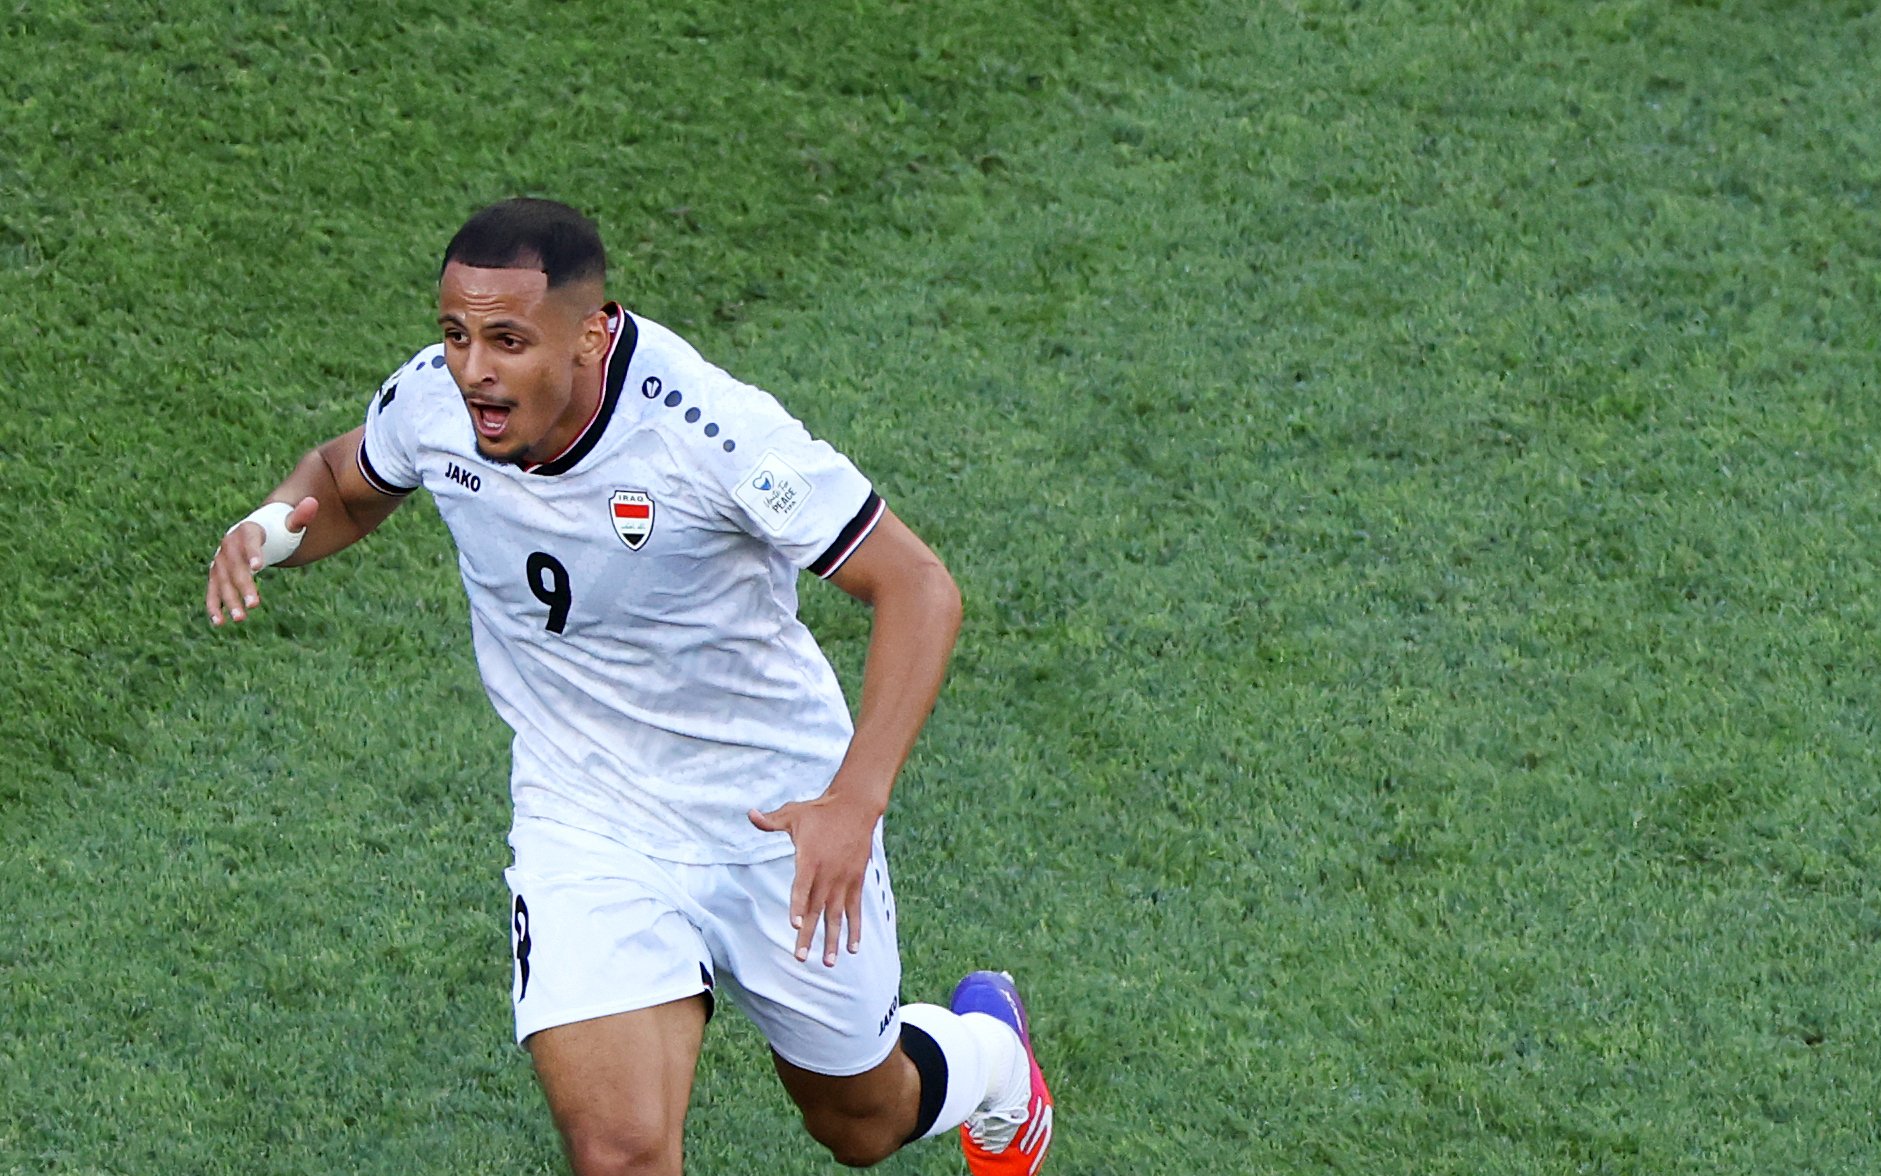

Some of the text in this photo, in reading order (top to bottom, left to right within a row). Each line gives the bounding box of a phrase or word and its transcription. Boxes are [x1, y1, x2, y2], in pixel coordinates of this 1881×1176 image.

[445, 462, 481, 492] JAKO
[772, 487, 797, 513] PEACE
[784, 501, 797, 514] FIFA
[526, 552, 572, 634] 9
